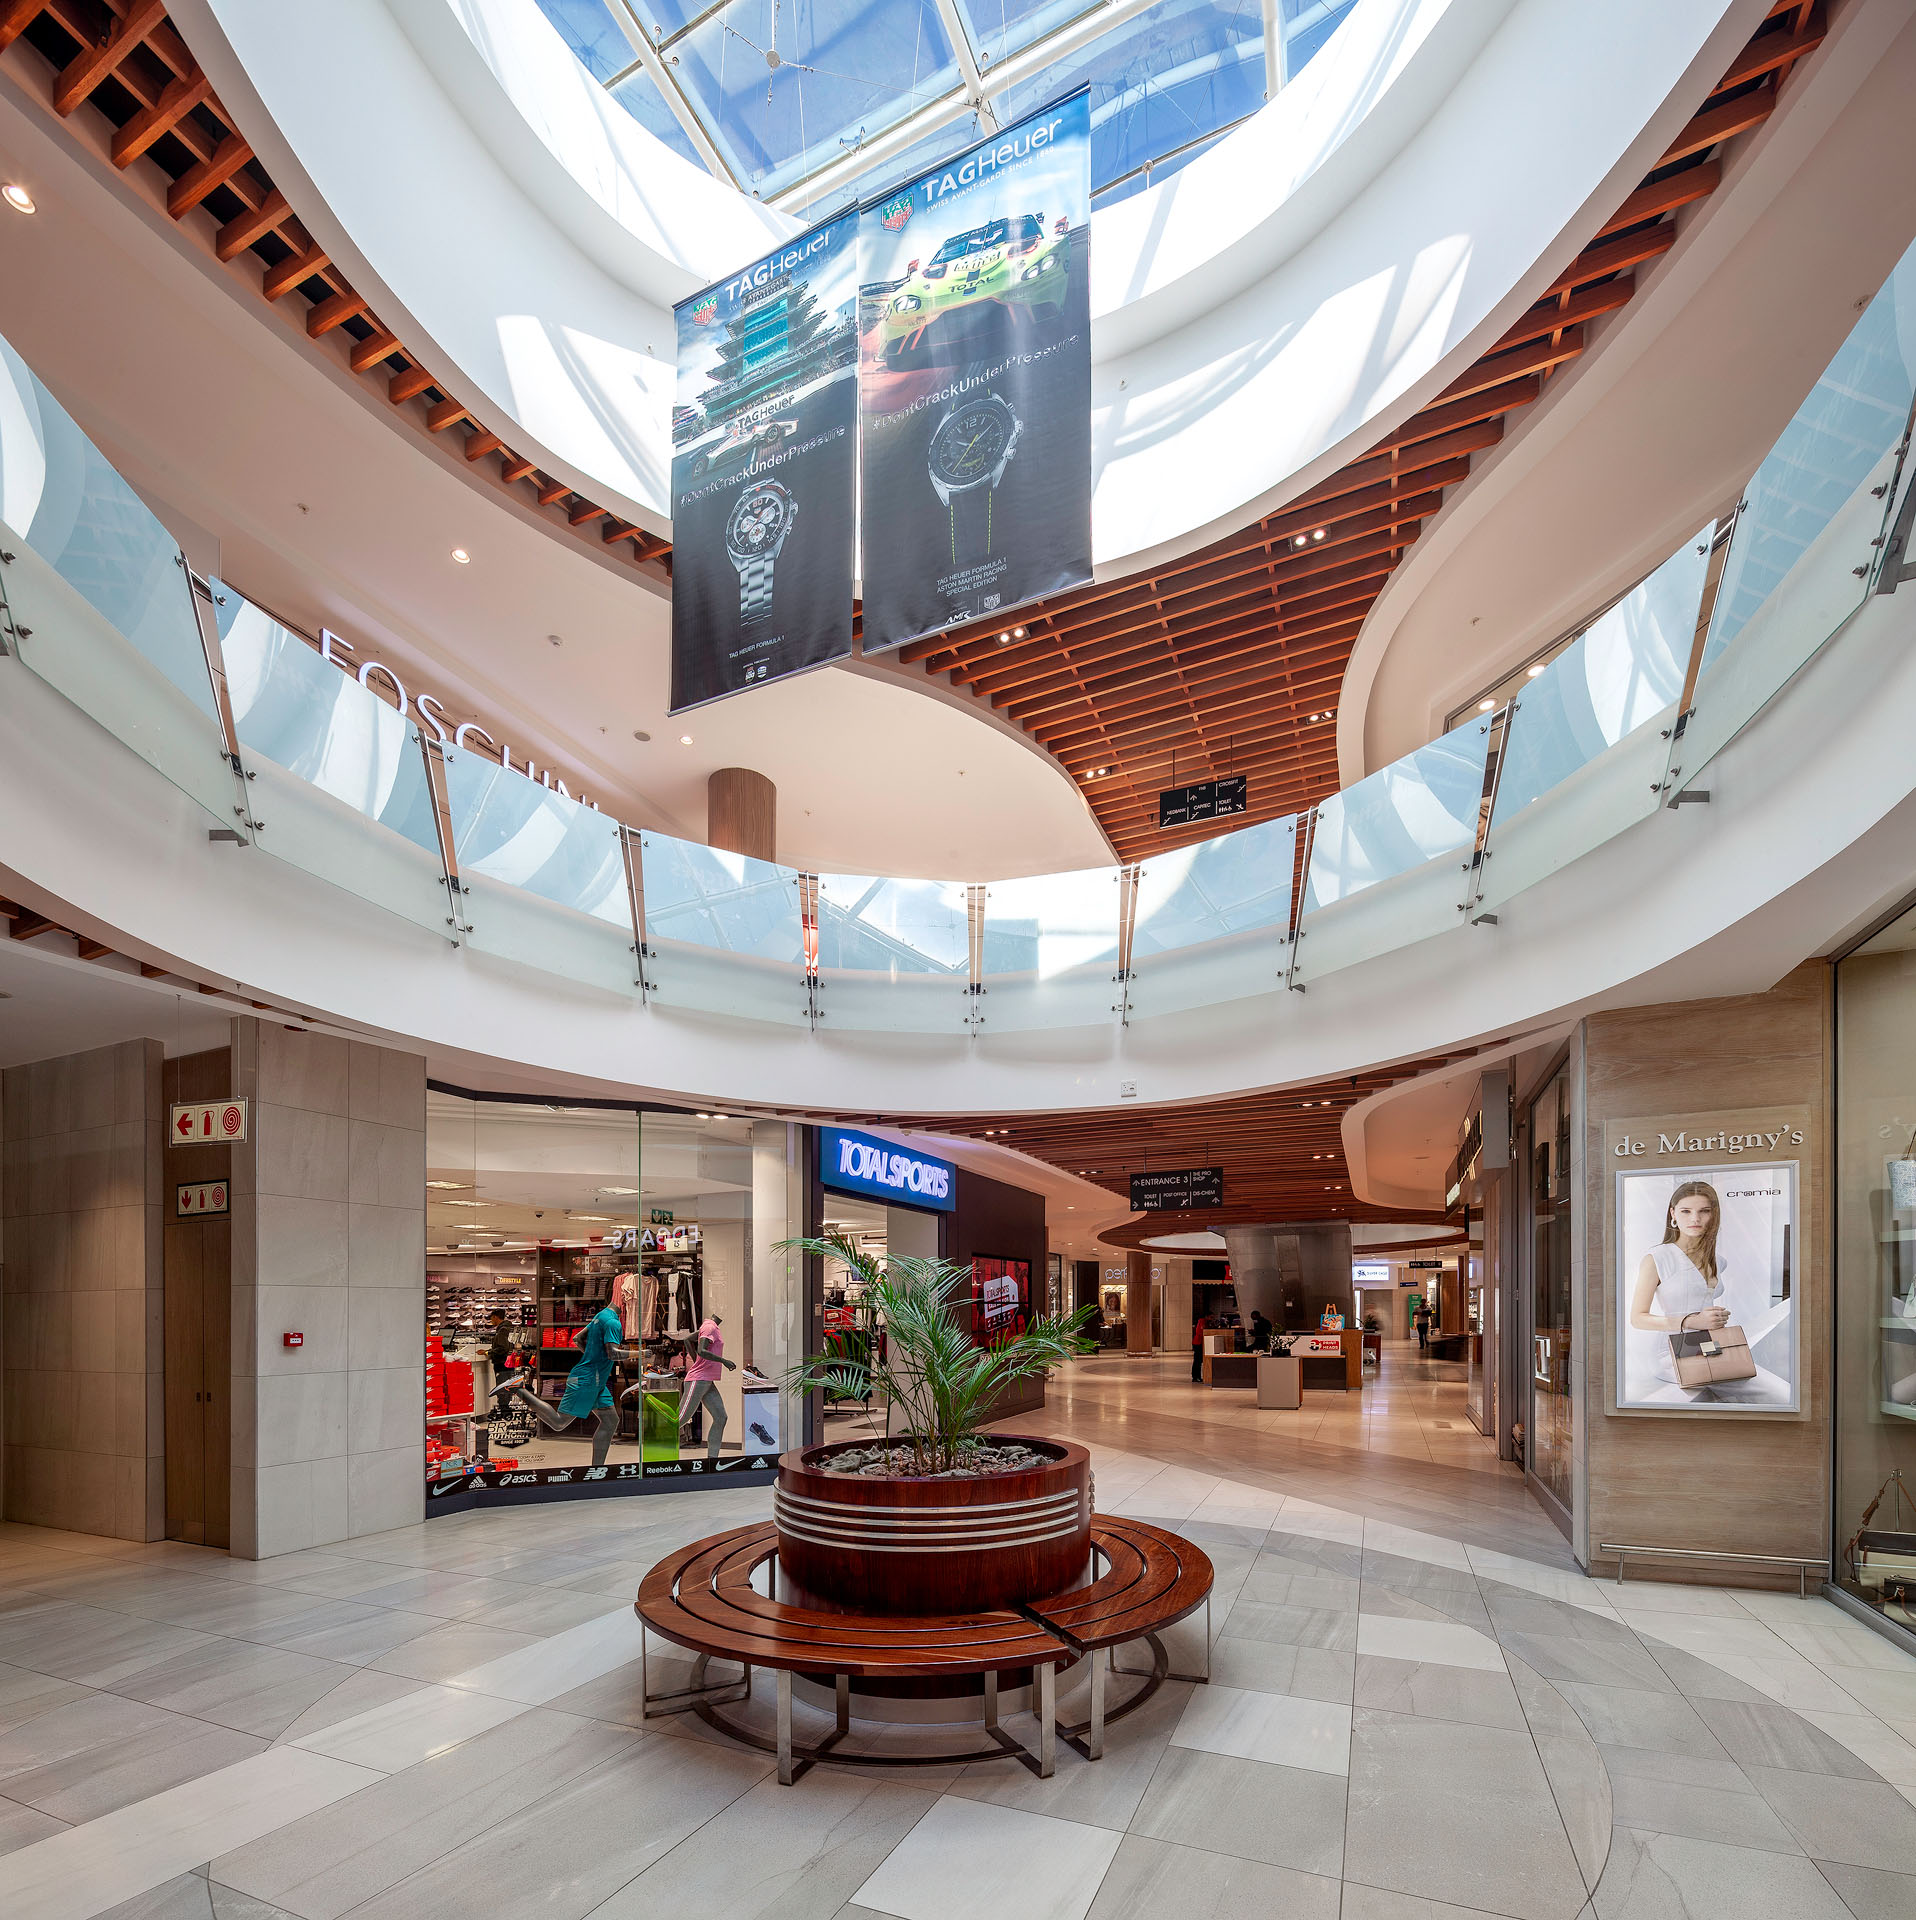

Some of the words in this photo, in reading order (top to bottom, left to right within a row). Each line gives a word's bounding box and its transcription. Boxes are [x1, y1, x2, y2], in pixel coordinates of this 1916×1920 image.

[926, 198, 949, 214] SWISS
[951, 170, 1006, 200] AVANT-GARDE
[1009, 156, 1033, 172] SINCE
[948, 276, 994, 292] TOTAL
[871, 334, 1079, 431] #DontCrackUnderPressure
[965, 418, 977, 429] 12
[681, 425, 846, 508] #DontCrackUnderPressure
[937, 576, 948, 586] TAG
[949, 570, 971, 580] HEUER
[971, 558, 1002, 575] FORMULA
[937, 581, 957, 593] ASTON
[957, 574, 982, 586] MARTIN
[983, 563, 1008, 578] RACING
[946, 585, 972, 597] SPECIAL
[973, 575, 998, 589] EDITION
[728, 650, 739, 659] TAG
[756, 636, 781, 649] FORMULA
[1614, 1135, 1646, 1157] de
[1657, 1124, 1804, 1154] Marigny's
[839, 1138, 949, 1198] TOTALSPORTS
[1140, 1176, 1180, 1187] ENTRANCE
[487, 1431, 537, 1440] AUTHORITY
[511, 1474, 537, 1484] asics
[547, 1475, 569, 1483] PUMA
[646, 1466, 673, 1474] Reebok
